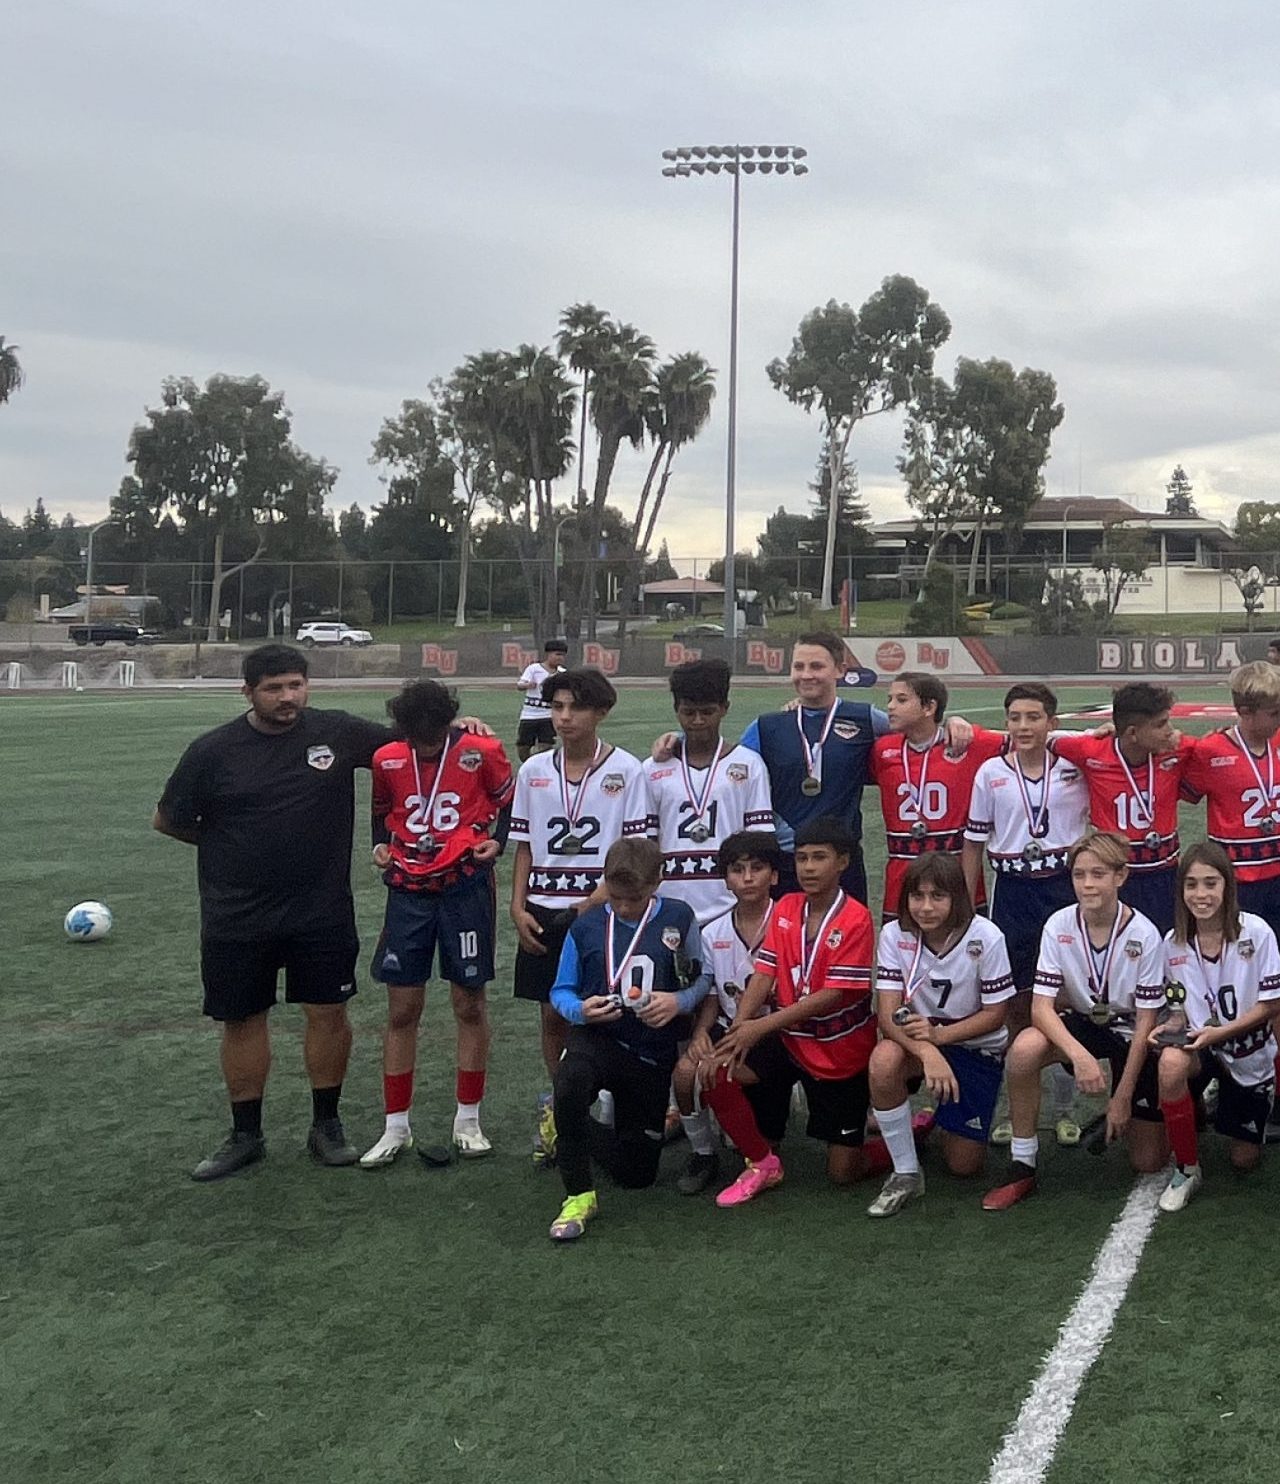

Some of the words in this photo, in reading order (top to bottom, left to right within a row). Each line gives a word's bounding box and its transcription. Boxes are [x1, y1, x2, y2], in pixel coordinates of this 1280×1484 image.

[422, 643, 458, 675] BU
[583, 642, 620, 675] BU
[747, 641, 784, 673] BU
[917, 642, 950, 669] BU
[1099, 638, 1243, 670] BIOLA
[404, 791, 461, 834] 26
[897, 782, 948, 821] 20
[547, 816, 600, 855] 22
[678, 800, 717, 839] 21
[459, 931, 478, 959] 10
[930, 978, 953, 1009] 7
